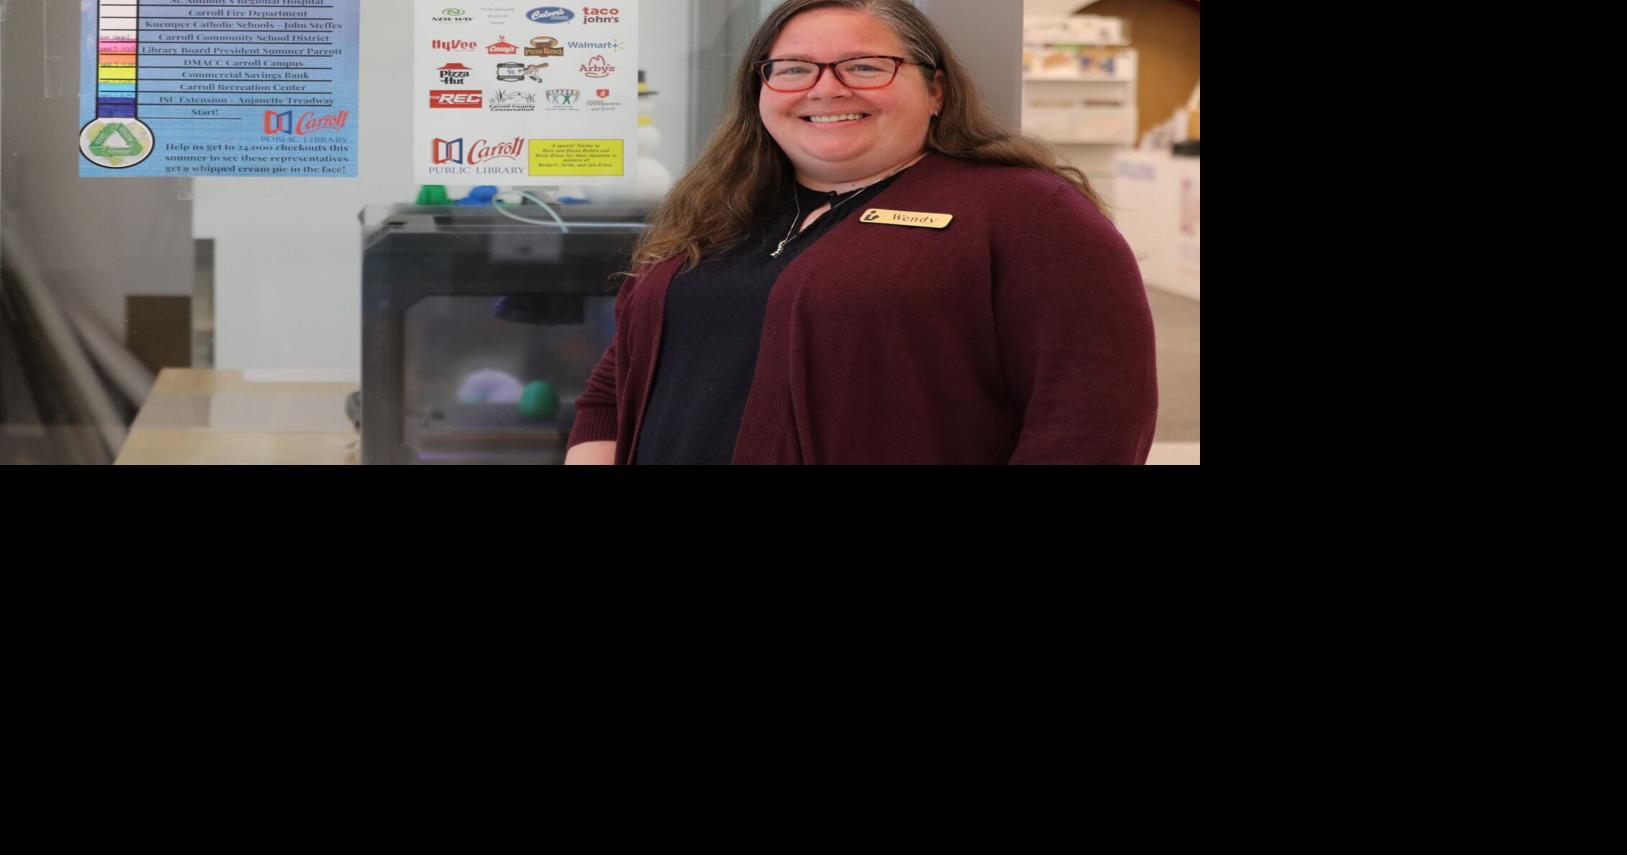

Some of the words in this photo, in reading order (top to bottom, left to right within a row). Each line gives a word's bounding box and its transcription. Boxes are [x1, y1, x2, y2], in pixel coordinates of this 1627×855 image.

[188, 9, 224, 17] Carroll
[226, 9, 247, 17] Fire
[249, 10, 307, 19] Department
[582, 6, 620, 15] taco
[582, 15, 620, 24] john's
[145, 20, 190, 29] Kuemper
[193, 20, 234, 28] Catholic
[236, 20, 274, 29] Schools
[284, 21, 307, 29] John
[158, 33, 194, 41] Carroll
[196, 33, 253, 42] Community
[292, 34, 330, 42] District
[568, 40, 611, 49] Walmart
[141, 46, 177, 55] Library
[181, 46, 210, 54] Board
[212, 47, 260, 55] President
[226, 59, 261, 67] Carroll
[263, 60, 304, 68] Campus
[579, 63, 616, 73] Arby's
[245, 71, 283, 80] Savings
[440, 70, 470, 78] Pizza
[180, 83, 215, 91] Carroll
[286, 97, 334, 105] Treadway
[439, 93, 482, 104] REC
[295, 111, 349, 135] Carroll
[166, 143, 191, 152] Help
[206, 144, 223, 152] get
[275, 144, 327, 152] checkouts
[467, 136, 525, 165] Carroll
[241, 154, 268, 162] these
[270, 155, 350, 164] representatives
[165, 165, 181, 173] get
[191, 165, 235, 173] whipped
[273, 165, 288, 174] pie
[321, 165, 346, 173] face!
[429, 167, 472, 175] PUBLIC
[476, 167, 525, 175] LIBRARY
[892, 213, 937, 224] Wendy
